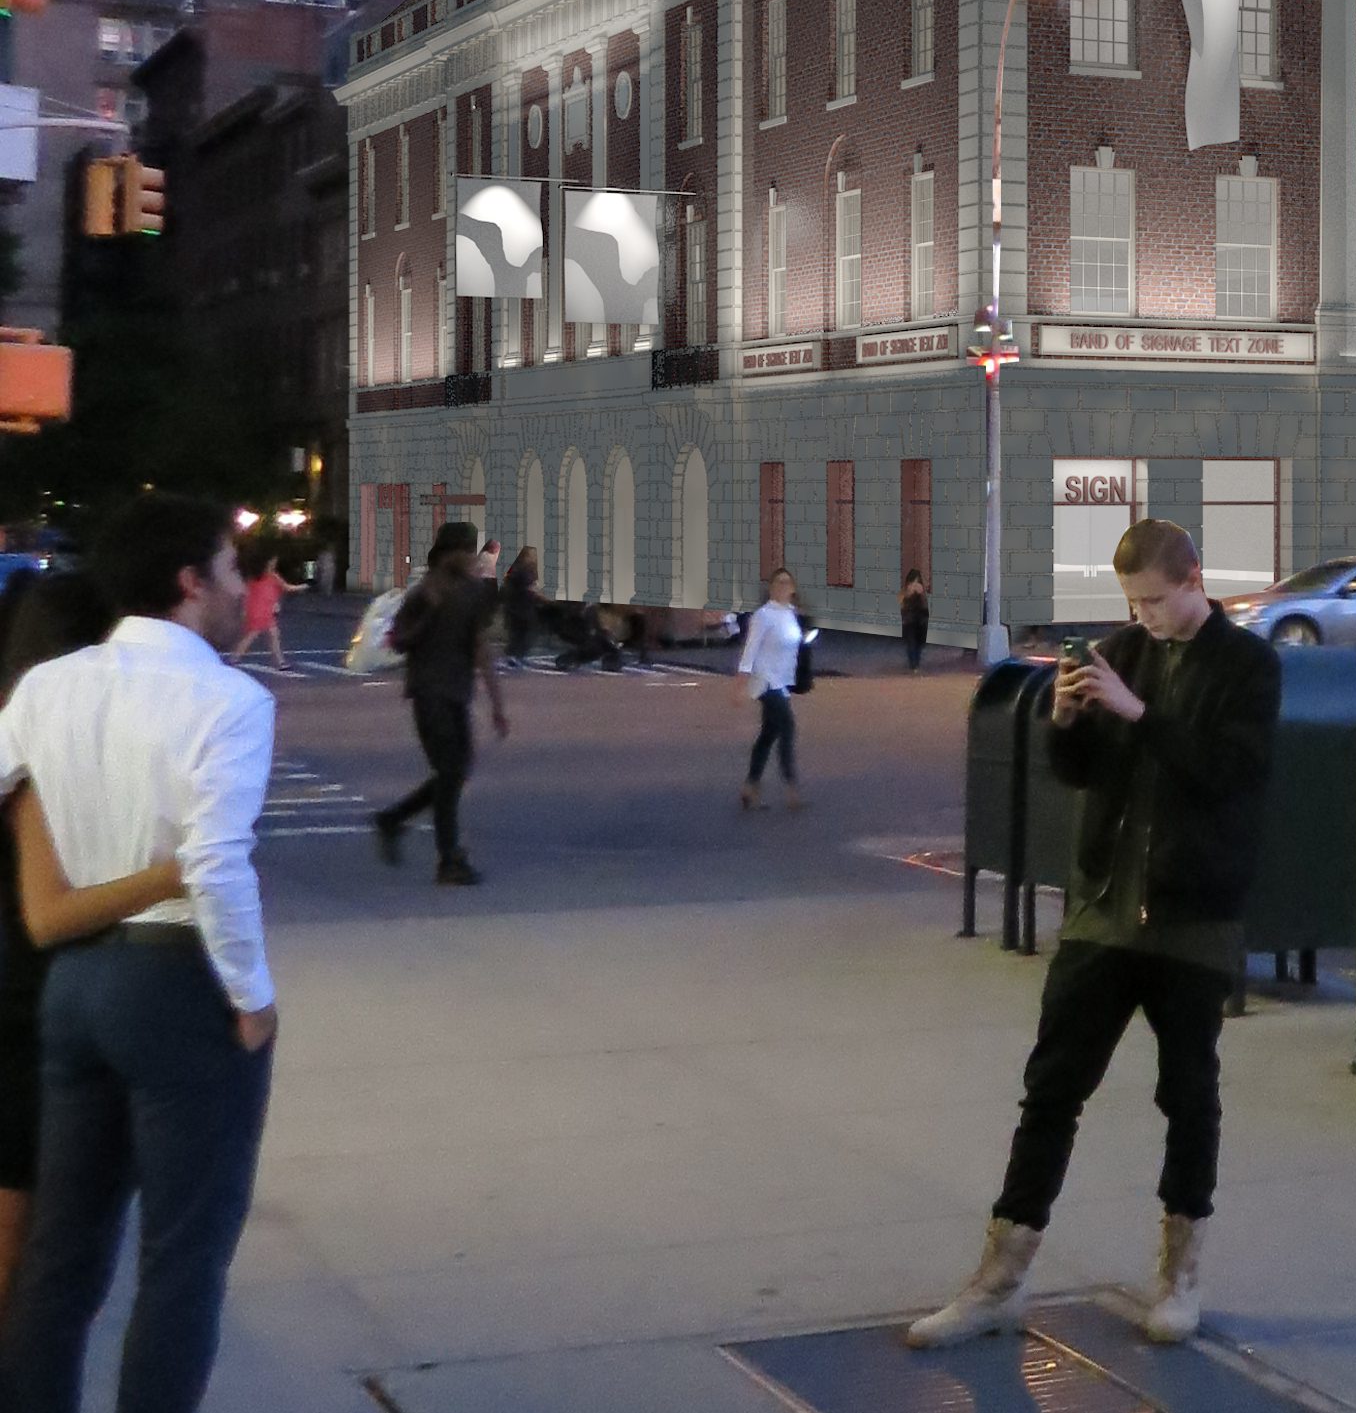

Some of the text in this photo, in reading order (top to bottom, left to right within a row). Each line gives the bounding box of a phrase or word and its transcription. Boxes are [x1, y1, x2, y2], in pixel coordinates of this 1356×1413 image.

[1069, 332, 1285, 355] BAND OF SIGNAGE TEXT ZONE
[1064, 475, 1127, 504] SIGN
